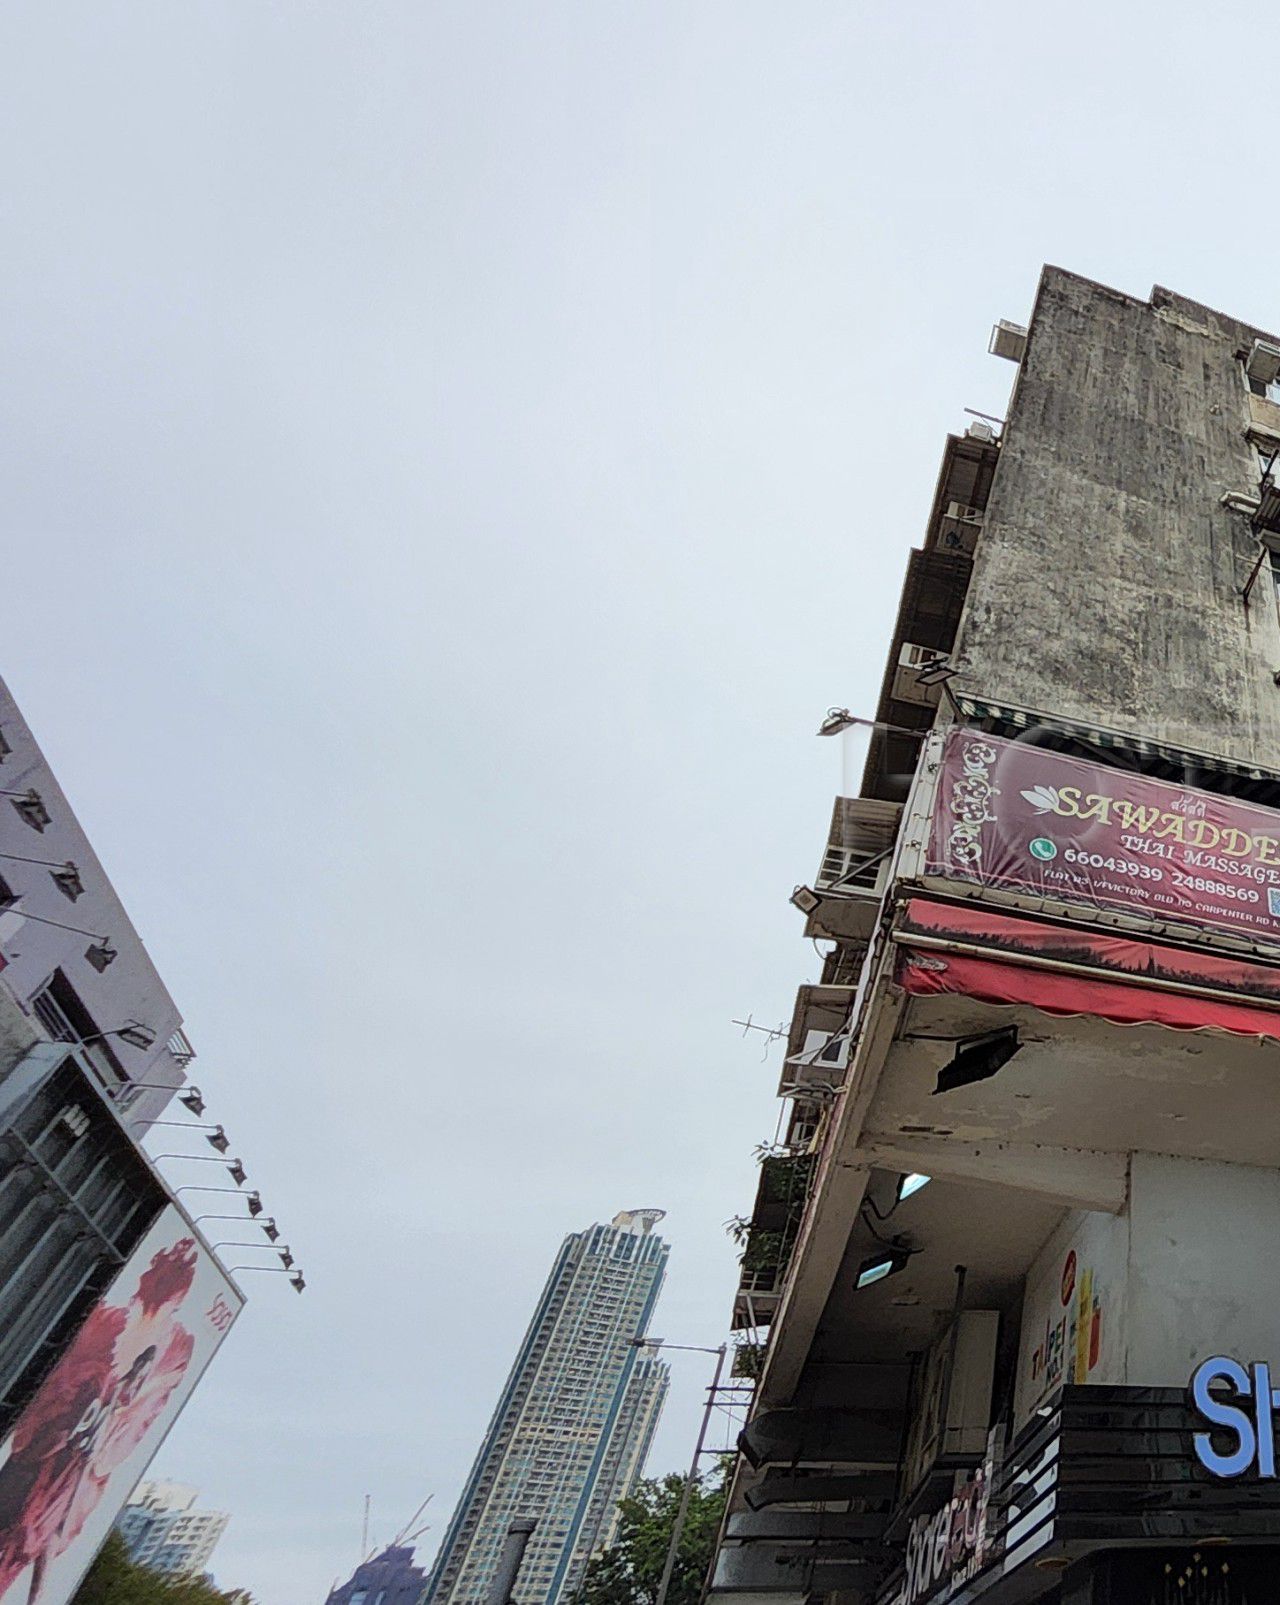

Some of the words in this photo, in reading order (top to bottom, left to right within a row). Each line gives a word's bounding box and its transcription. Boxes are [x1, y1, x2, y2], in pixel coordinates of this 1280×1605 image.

[1064, 848, 1163, 882] 66043939
[1171, 873, 1260, 903] 24888569
[1120, 834, 1173, 860] THAI
[1183, 850, 1280, 885] MASSAGE
[1195, 901, 1254, 922] CARPENTER
[1255, 912, 1270, 924] RD
